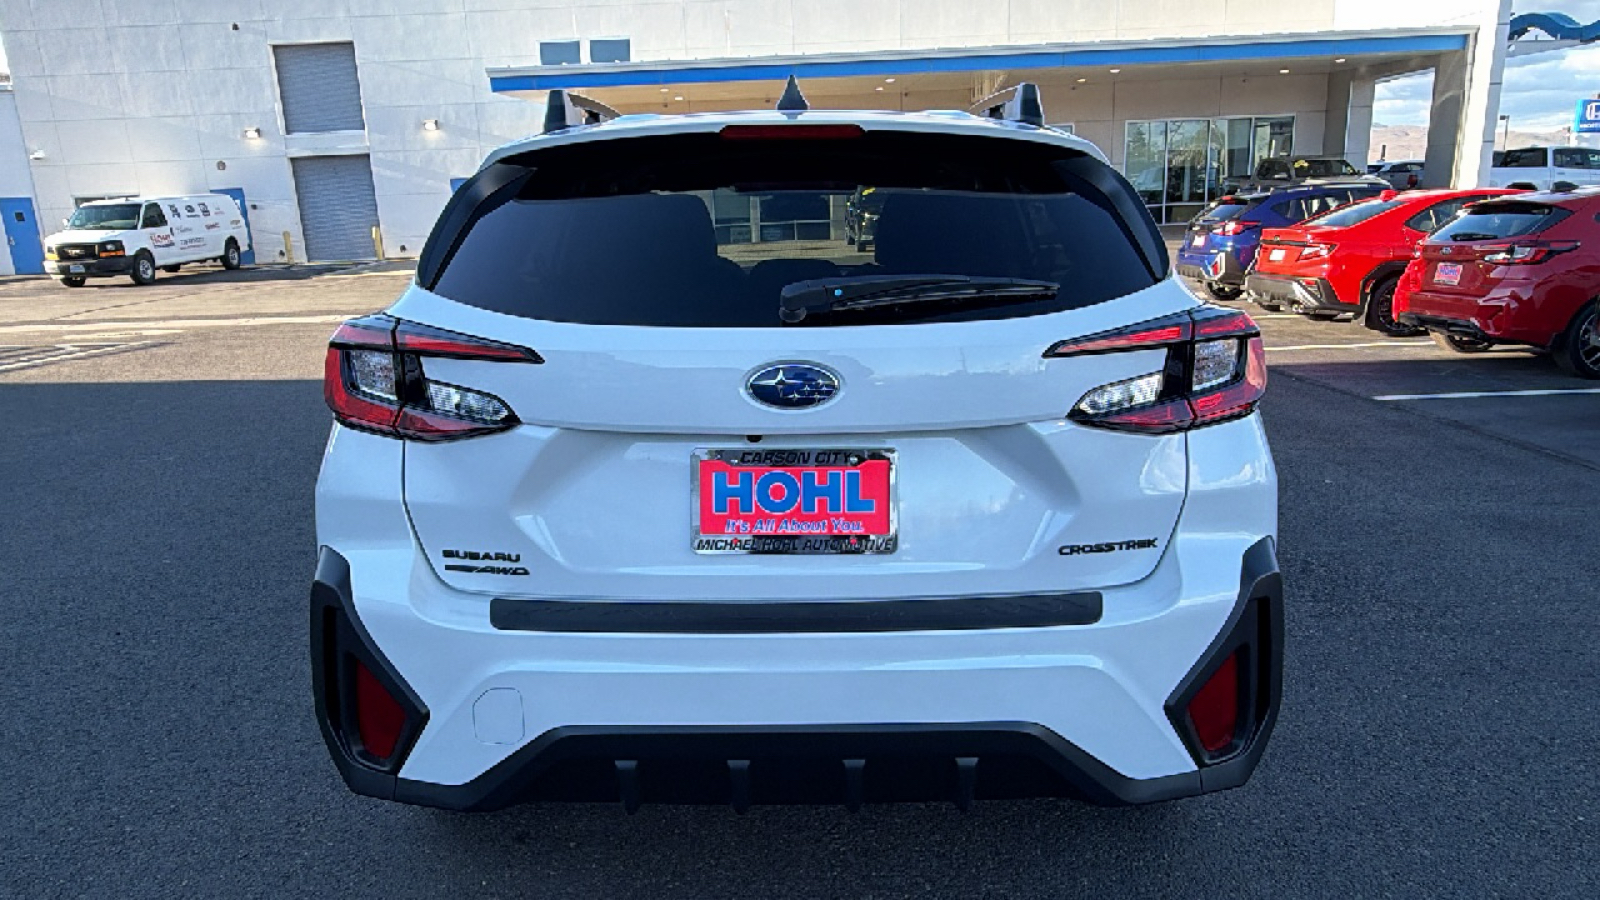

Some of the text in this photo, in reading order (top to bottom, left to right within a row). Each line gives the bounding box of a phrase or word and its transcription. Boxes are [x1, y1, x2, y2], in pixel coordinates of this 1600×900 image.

[739, 452, 852, 464] CARSON CITY
[712, 470, 876, 515] HOHL
[724, 518, 750, 533] It's
[752, 518, 776, 533] All
[778, 518, 828, 533] About
[696, 538, 894, 551] MICHAEL HOHL AUTOMOTIVE
[1058, 537, 1158, 556] CROSSTREK
[442, 549, 521, 563] SUBARU
[475, 565, 531, 576] AWD
